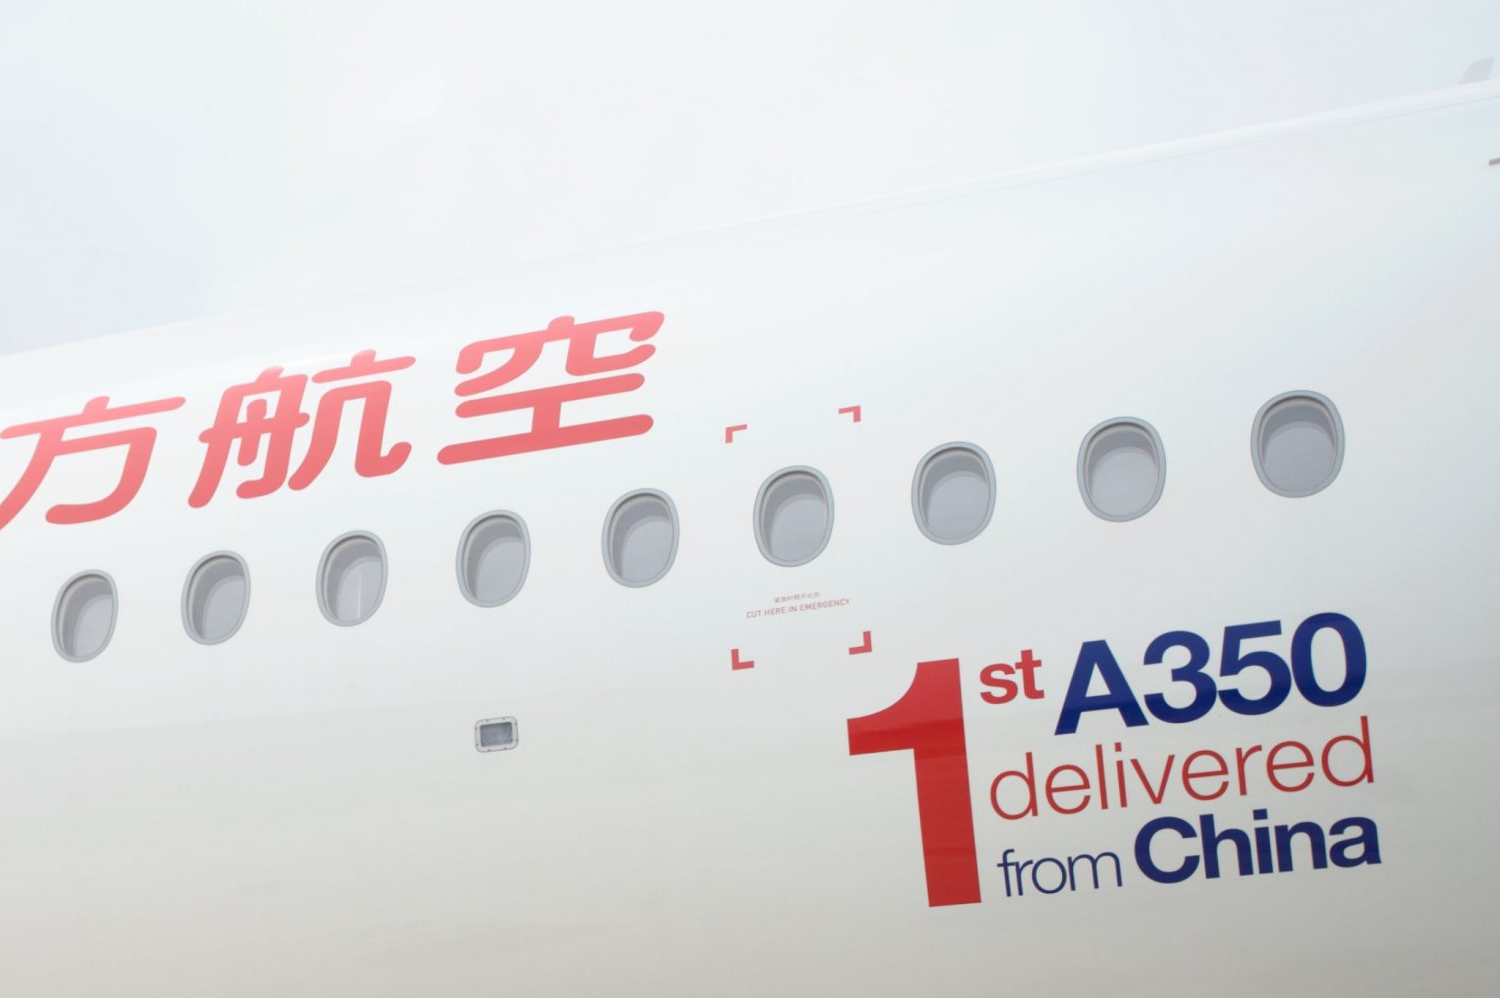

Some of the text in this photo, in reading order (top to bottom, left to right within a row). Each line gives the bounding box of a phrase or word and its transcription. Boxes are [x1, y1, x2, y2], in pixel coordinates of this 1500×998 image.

[746, 598, 851, 619] CUT HERE IN EMERGENCY
[1054, 611, 1368, 736] A350
[989, 714, 1375, 821] delivered
[996, 808, 1382, 898] from China
